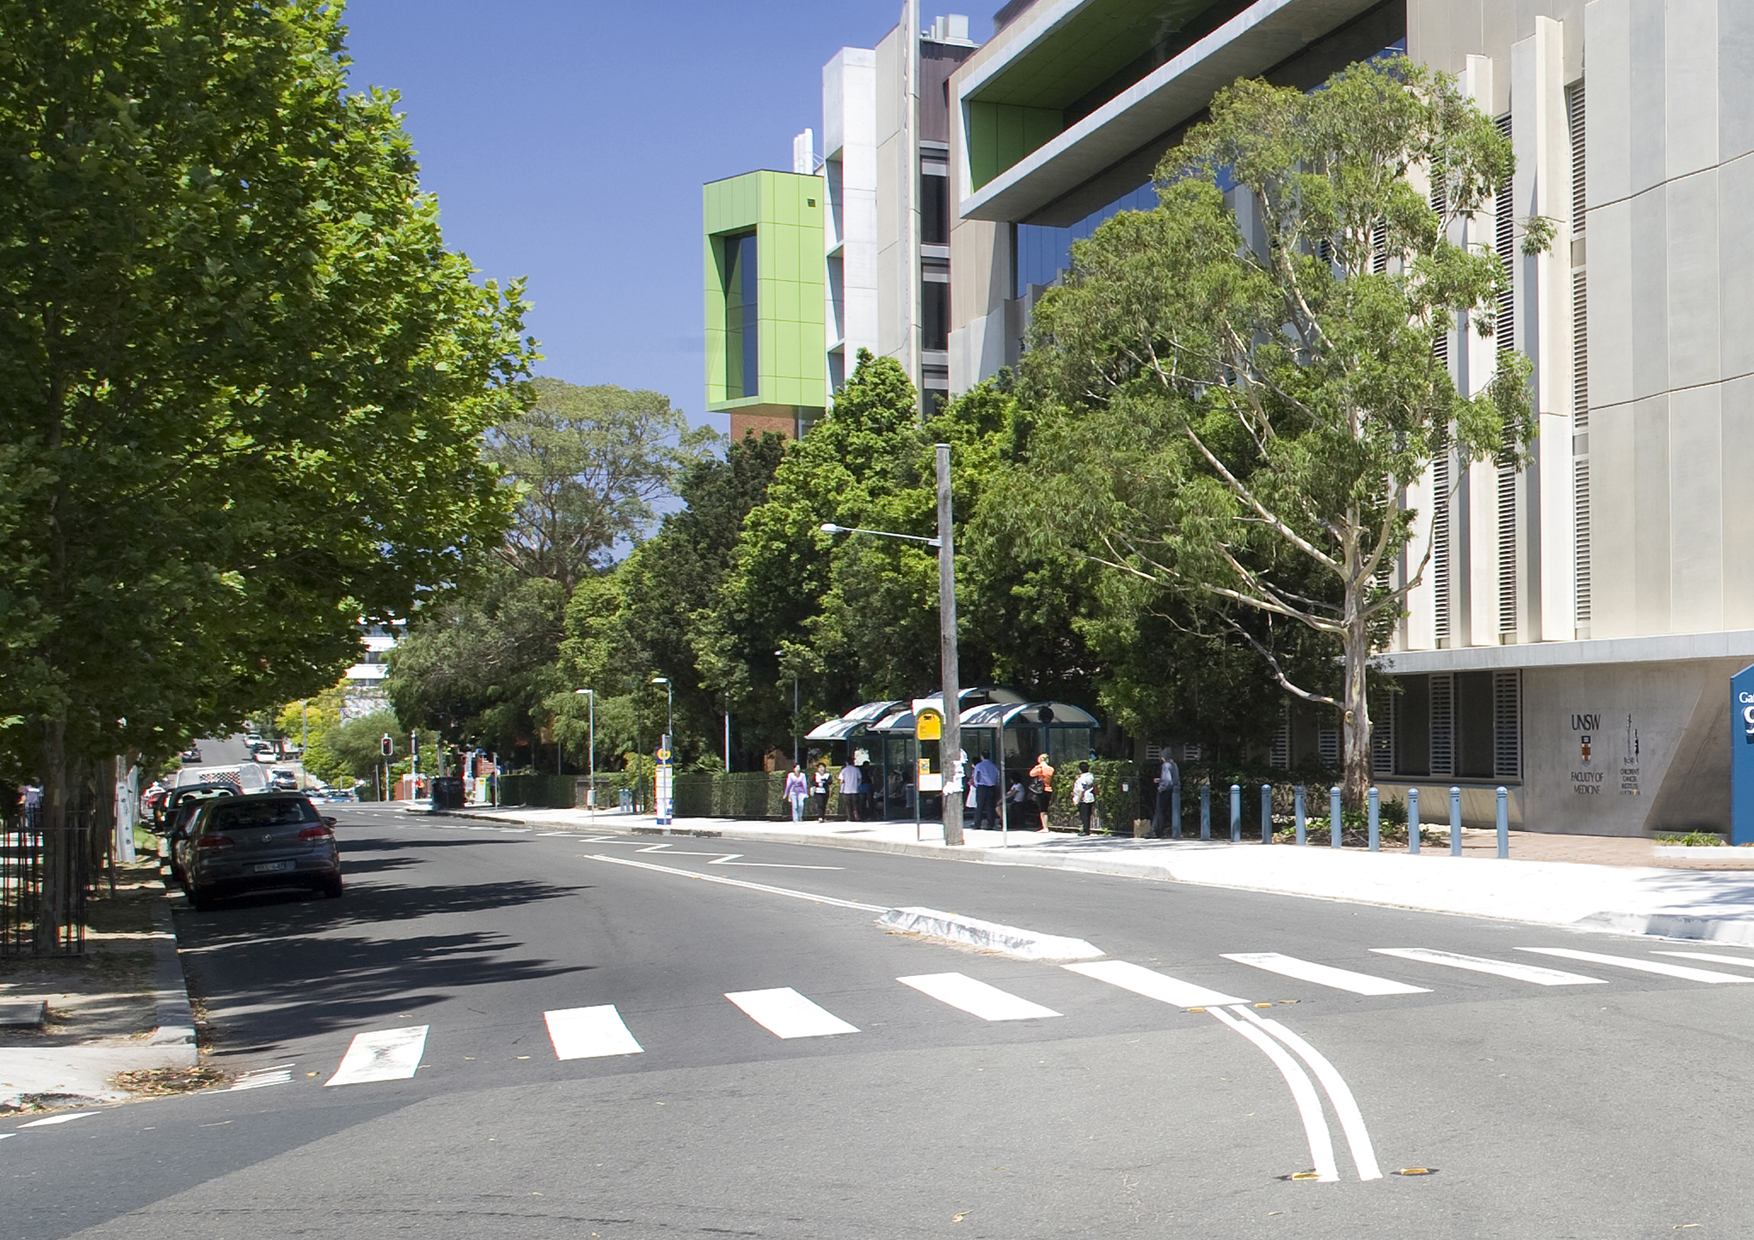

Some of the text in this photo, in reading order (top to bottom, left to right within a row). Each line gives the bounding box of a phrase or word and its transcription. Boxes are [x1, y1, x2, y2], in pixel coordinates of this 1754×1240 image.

[1571, 714, 1601, 731] UNSW
[1571, 772, 1604, 782] FACULTY OF
[1574, 784, 1601, 794] MEDICINE
